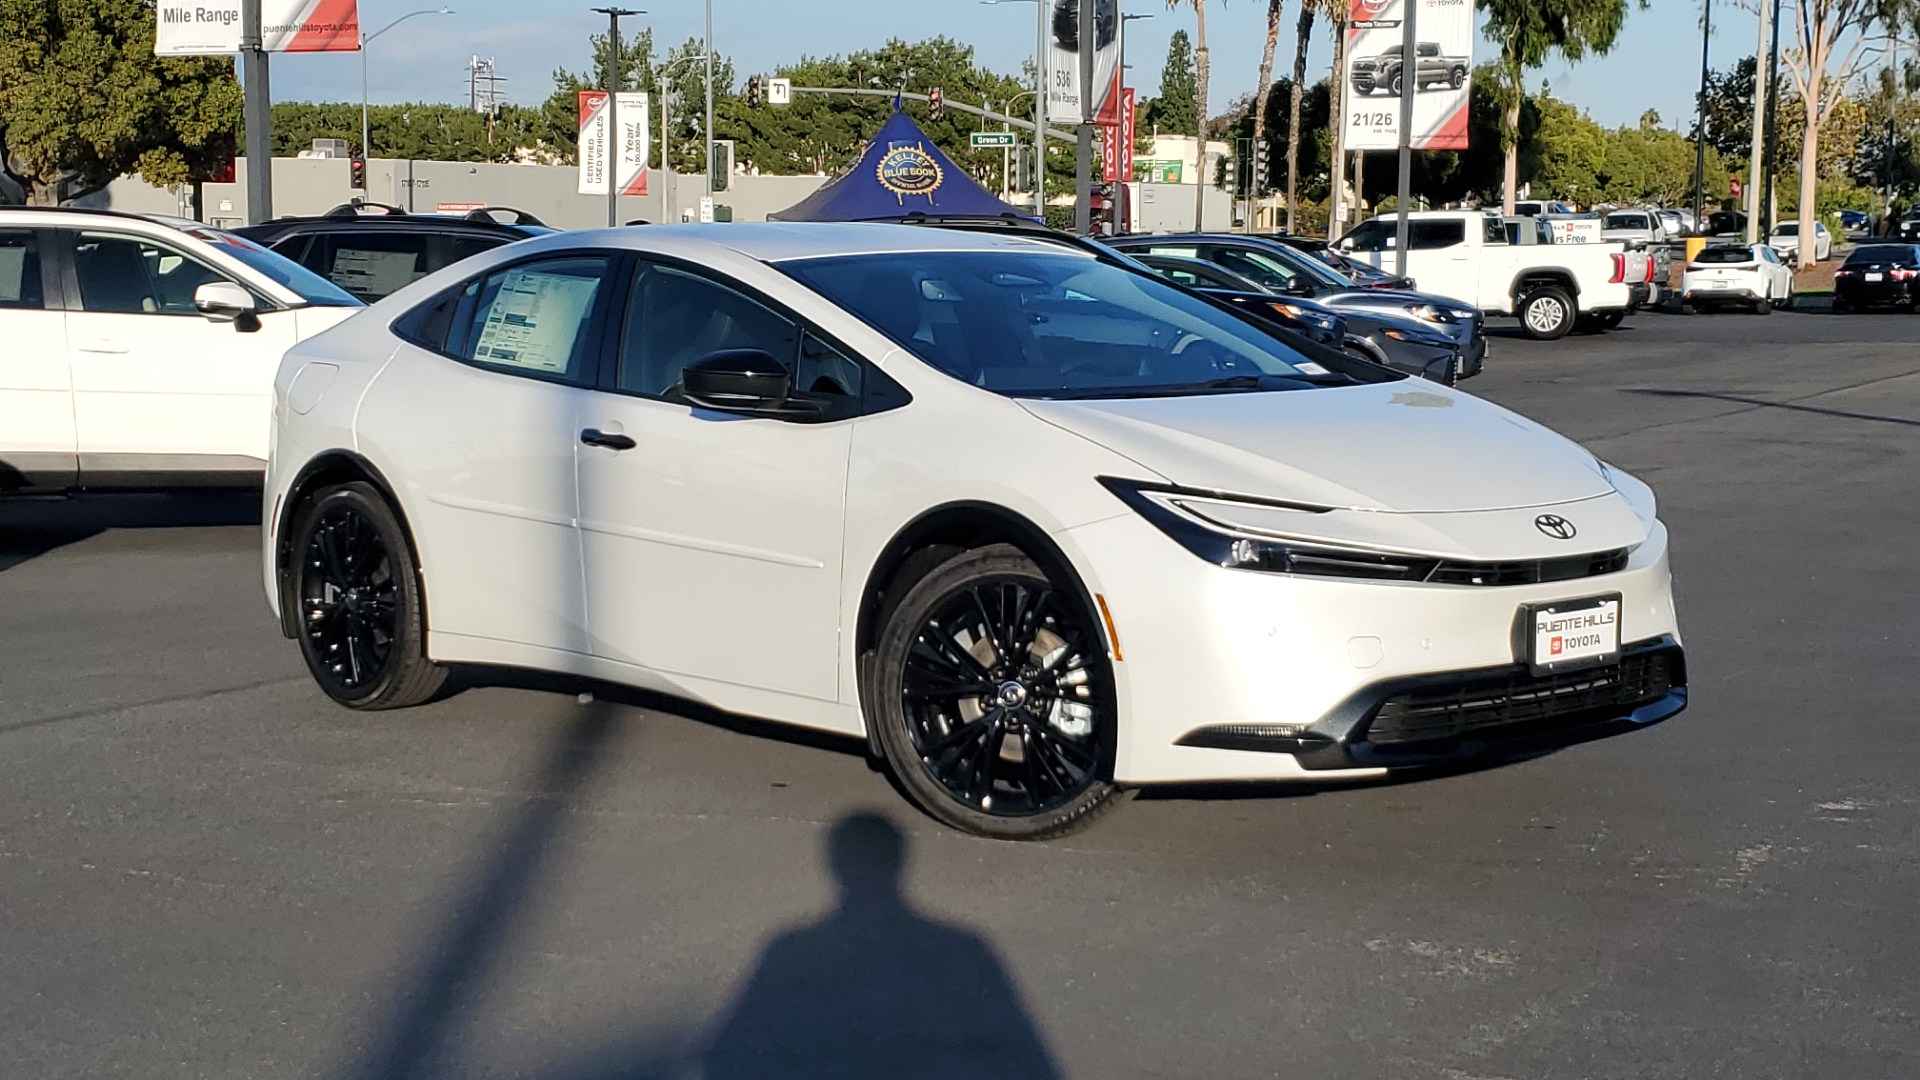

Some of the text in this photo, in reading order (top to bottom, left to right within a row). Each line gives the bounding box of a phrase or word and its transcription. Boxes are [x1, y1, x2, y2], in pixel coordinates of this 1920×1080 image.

[163, 7, 239, 25] Mile Range
[263, 22, 358, 34] puentehillstoyota.com
[1056, 70, 1071, 88] 536
[1352, 112, 1393, 127] 21/26
[625, 122, 634, 153] Year/
[977, 136, 1009, 144] Green Dr
[1121, 94, 1132, 177] TOYOTA
[887, 152, 931, 167] KELLEY
[595, 160, 603, 183] USED
[883, 167, 936, 177] BLUE BOOK
[1566, 234, 1587, 243] Free
[1537, 612, 1614, 633] PUENTE HILLS
[1564, 634, 1600, 649] TOYOTA
